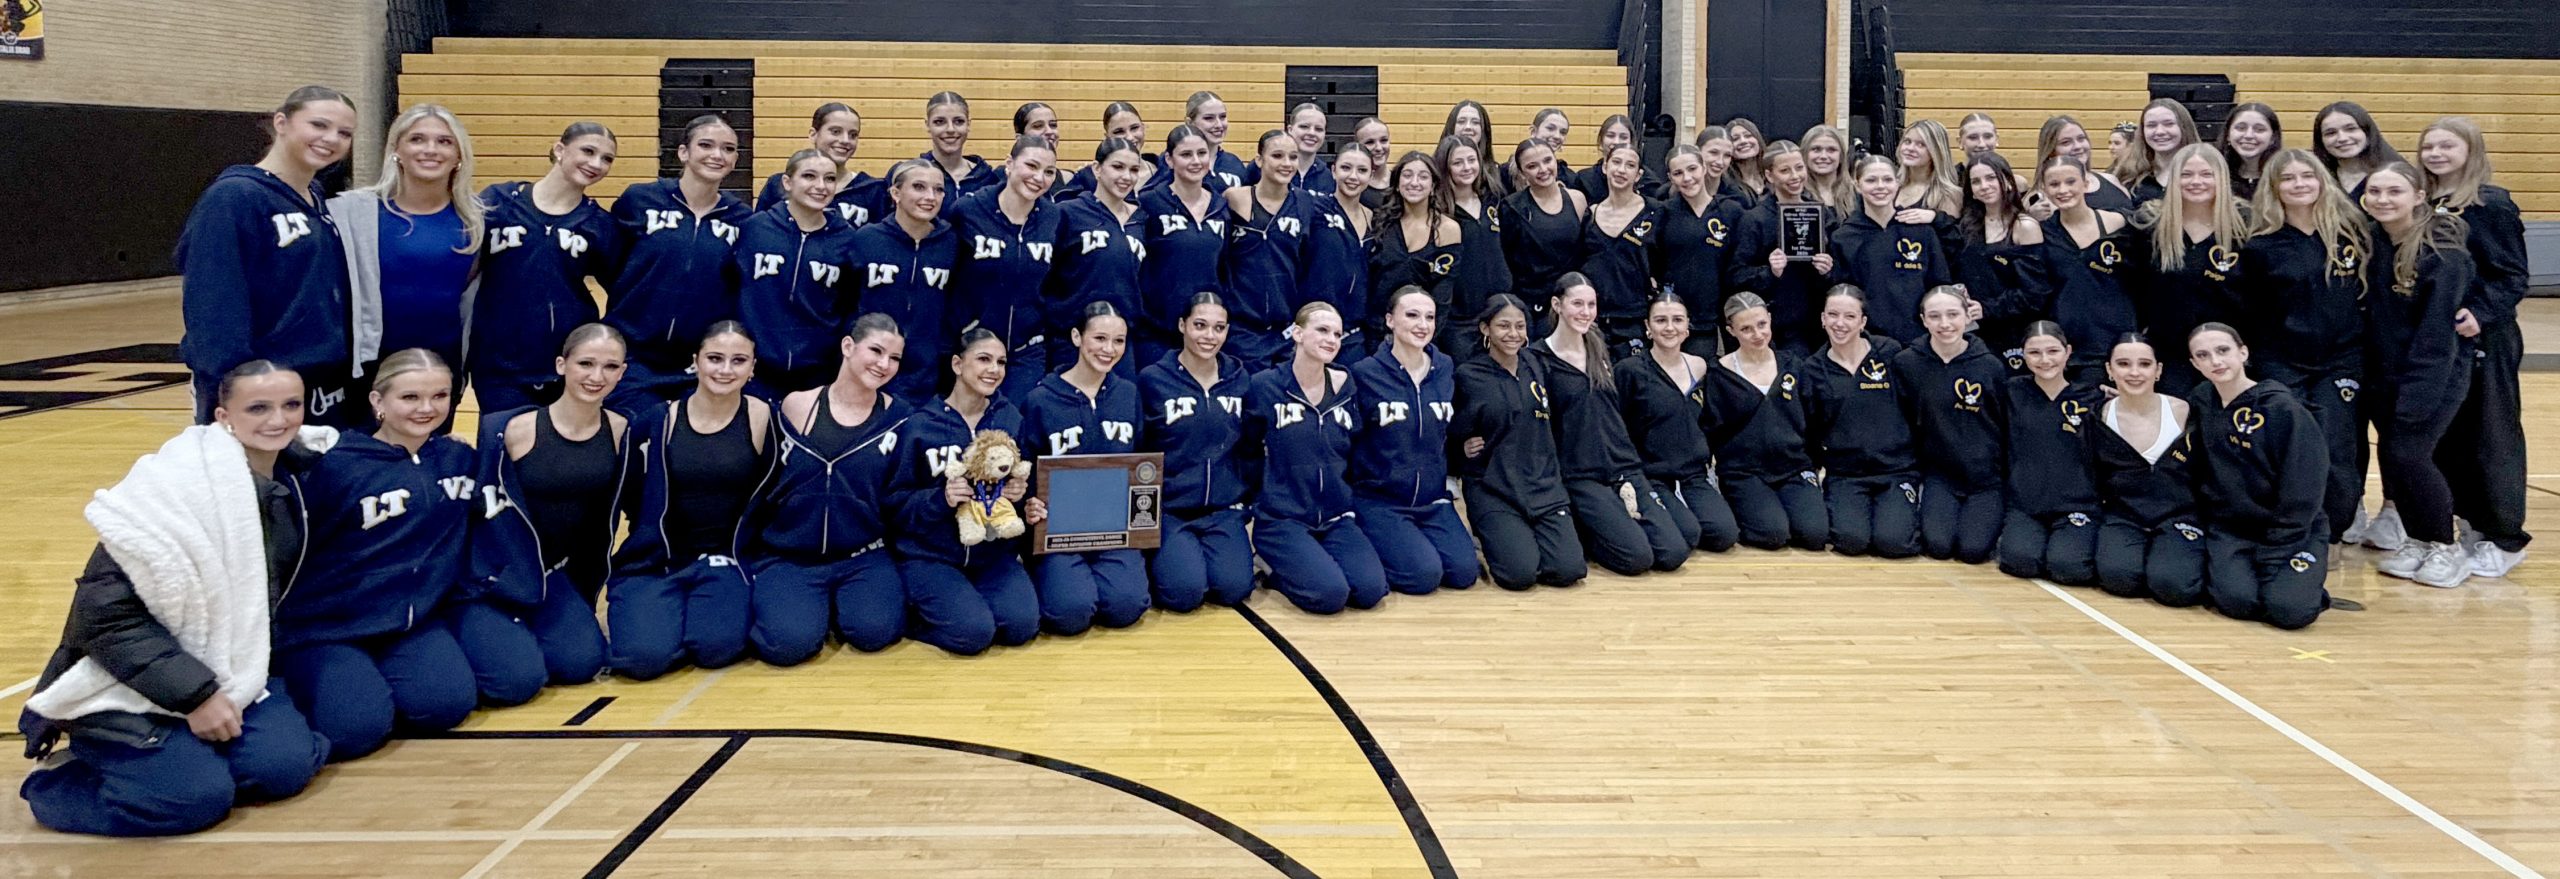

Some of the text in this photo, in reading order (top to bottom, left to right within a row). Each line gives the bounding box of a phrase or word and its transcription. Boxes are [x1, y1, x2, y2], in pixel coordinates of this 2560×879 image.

[646, 209, 683, 235] LT
[838, 202, 869, 227] VP
[1159, 214, 1188, 235] LT
[1277, 216, 1300, 238] VP
[272, 212, 311, 247] LT
[490, 226, 588, 258] LT VP
[1080, 230, 1110, 255] LT
[973, 235, 1006, 260] LT
[754, 253, 840, 288] LT VP
[867, 262, 899, 288] LT
[1164, 396, 1197, 425] LT
[1274, 403, 1305, 430] LT
[1378, 401, 1409, 427] LT
[1049, 421, 1133, 455] LT VP
[925, 445, 962, 477] LT
[360, 488, 411, 530] LT
